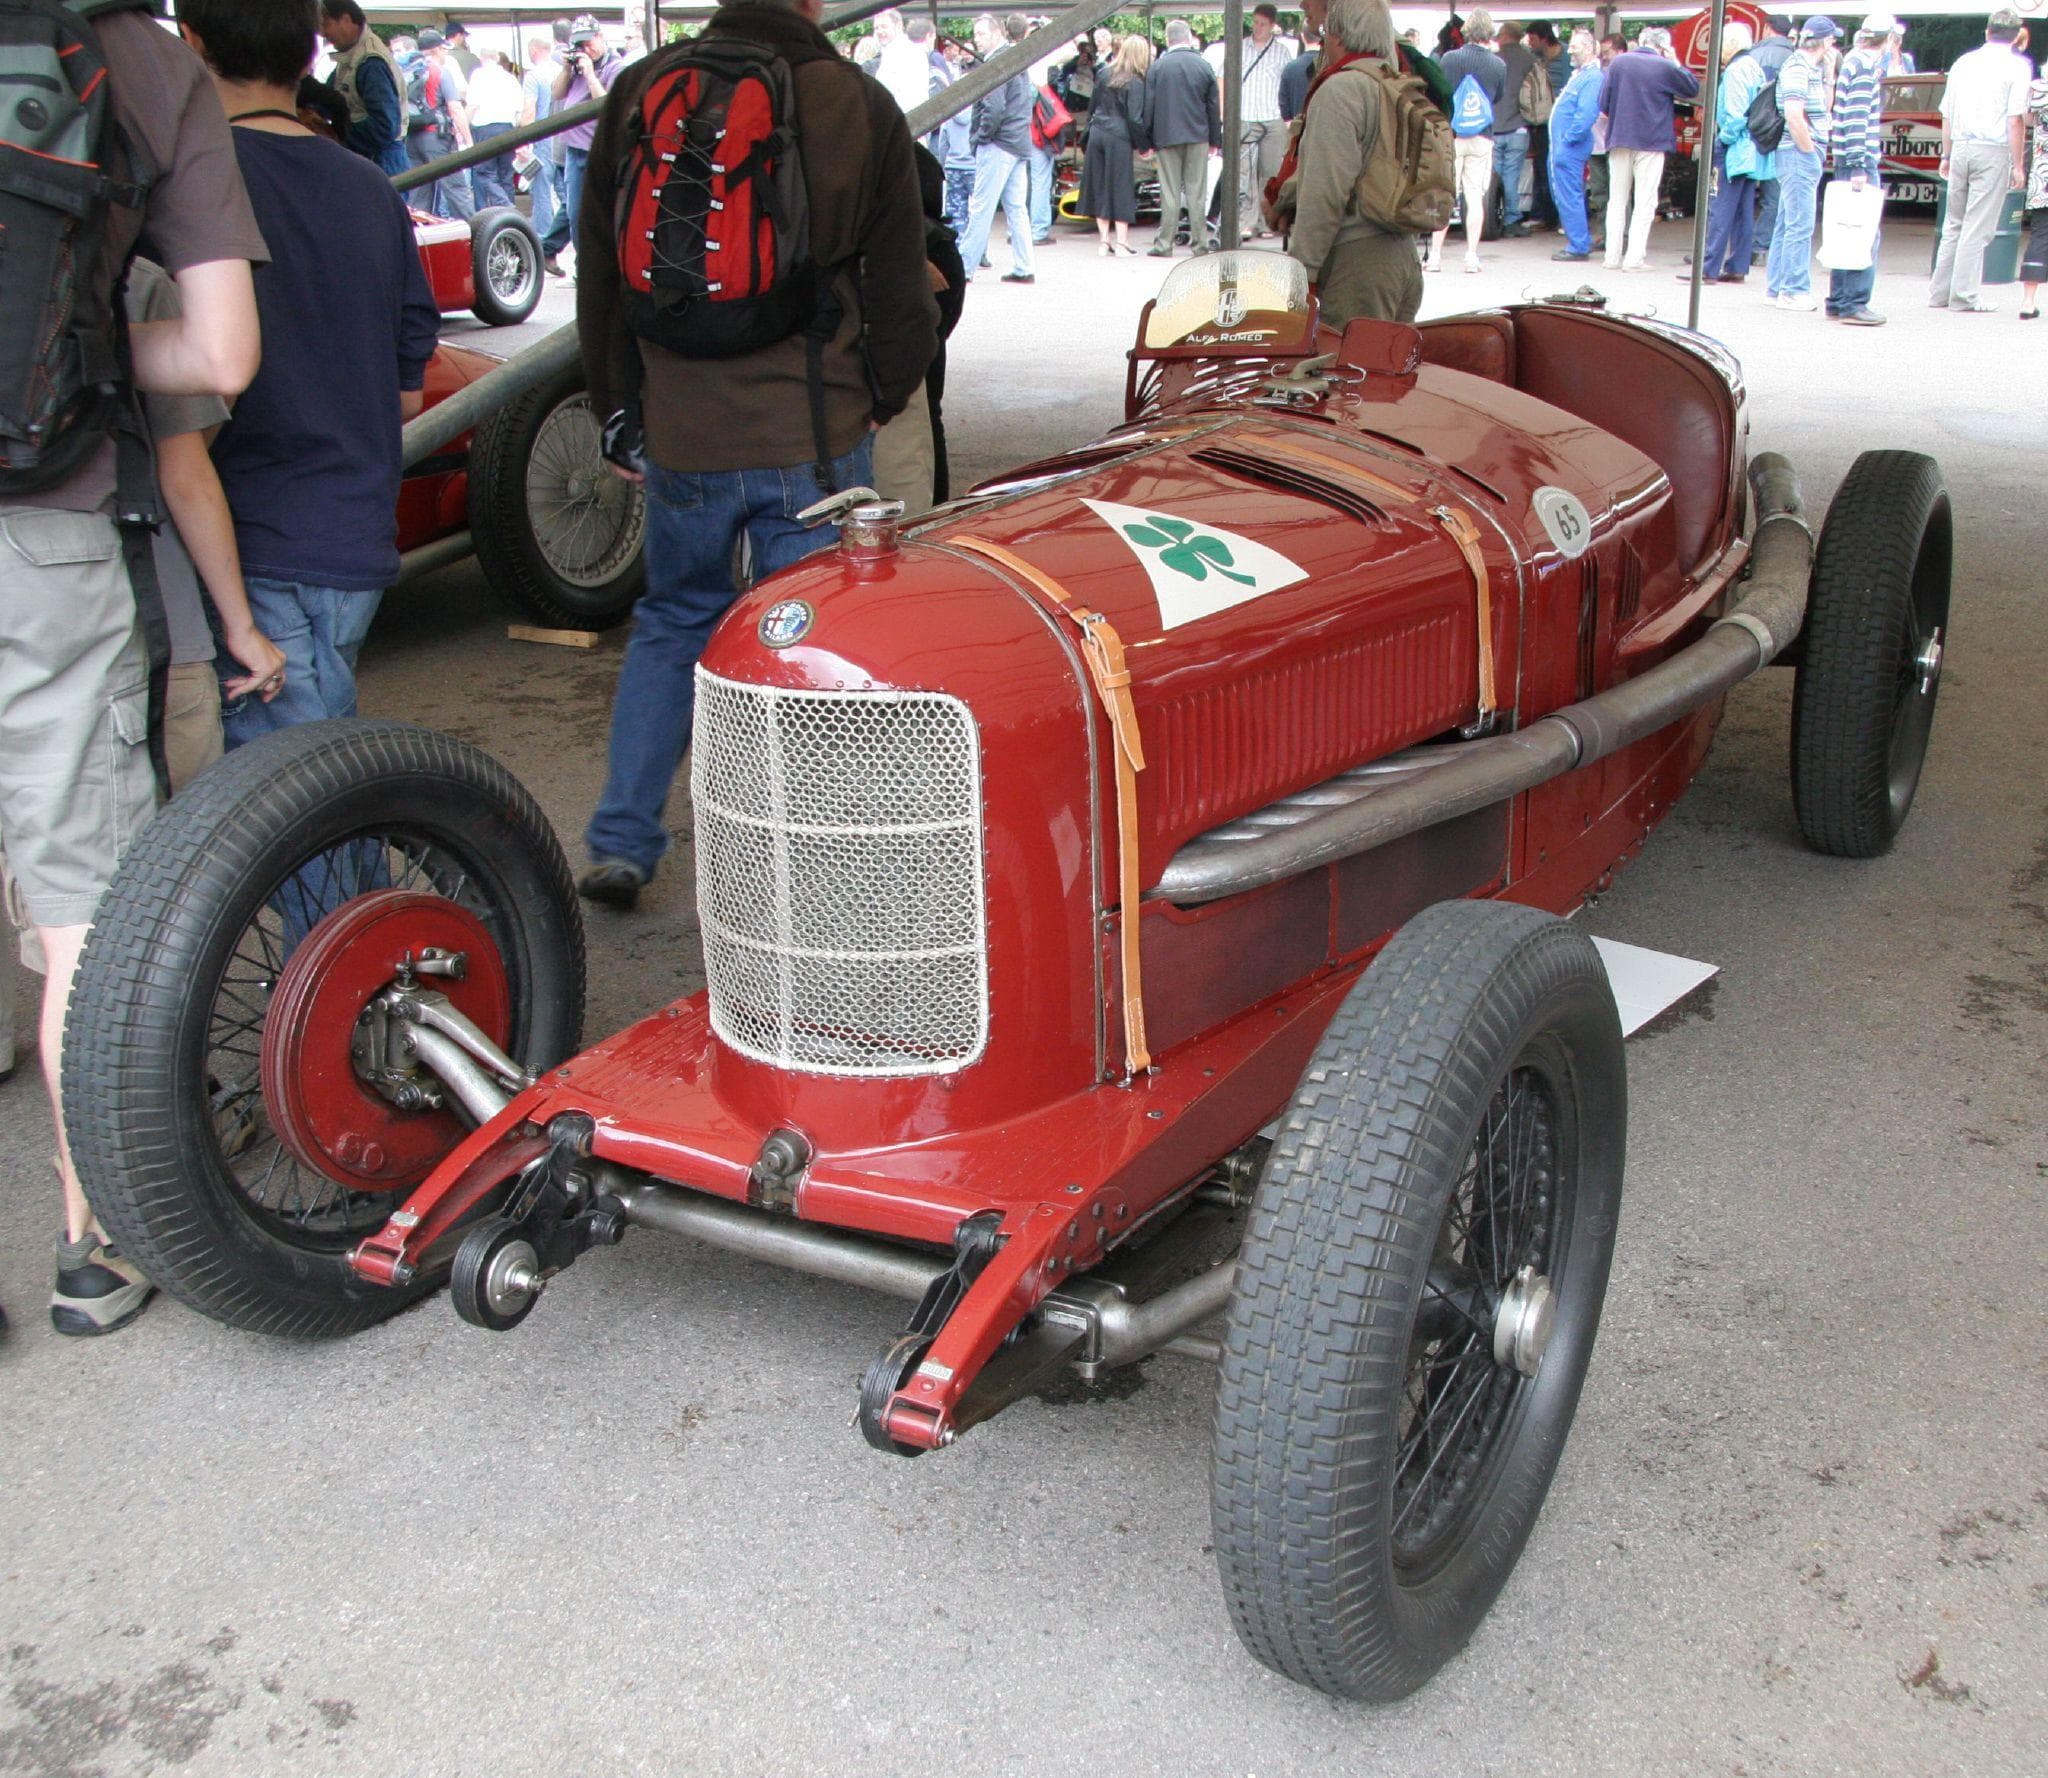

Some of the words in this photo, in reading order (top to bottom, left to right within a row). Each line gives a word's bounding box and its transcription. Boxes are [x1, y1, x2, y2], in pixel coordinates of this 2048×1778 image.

[1880, 135, 1943, 156] rlboro
[1186, 333, 1215, 343] ALFA
[1220, 333, 1263, 342] ROMEO
[1555, 504, 1580, 540] 65
